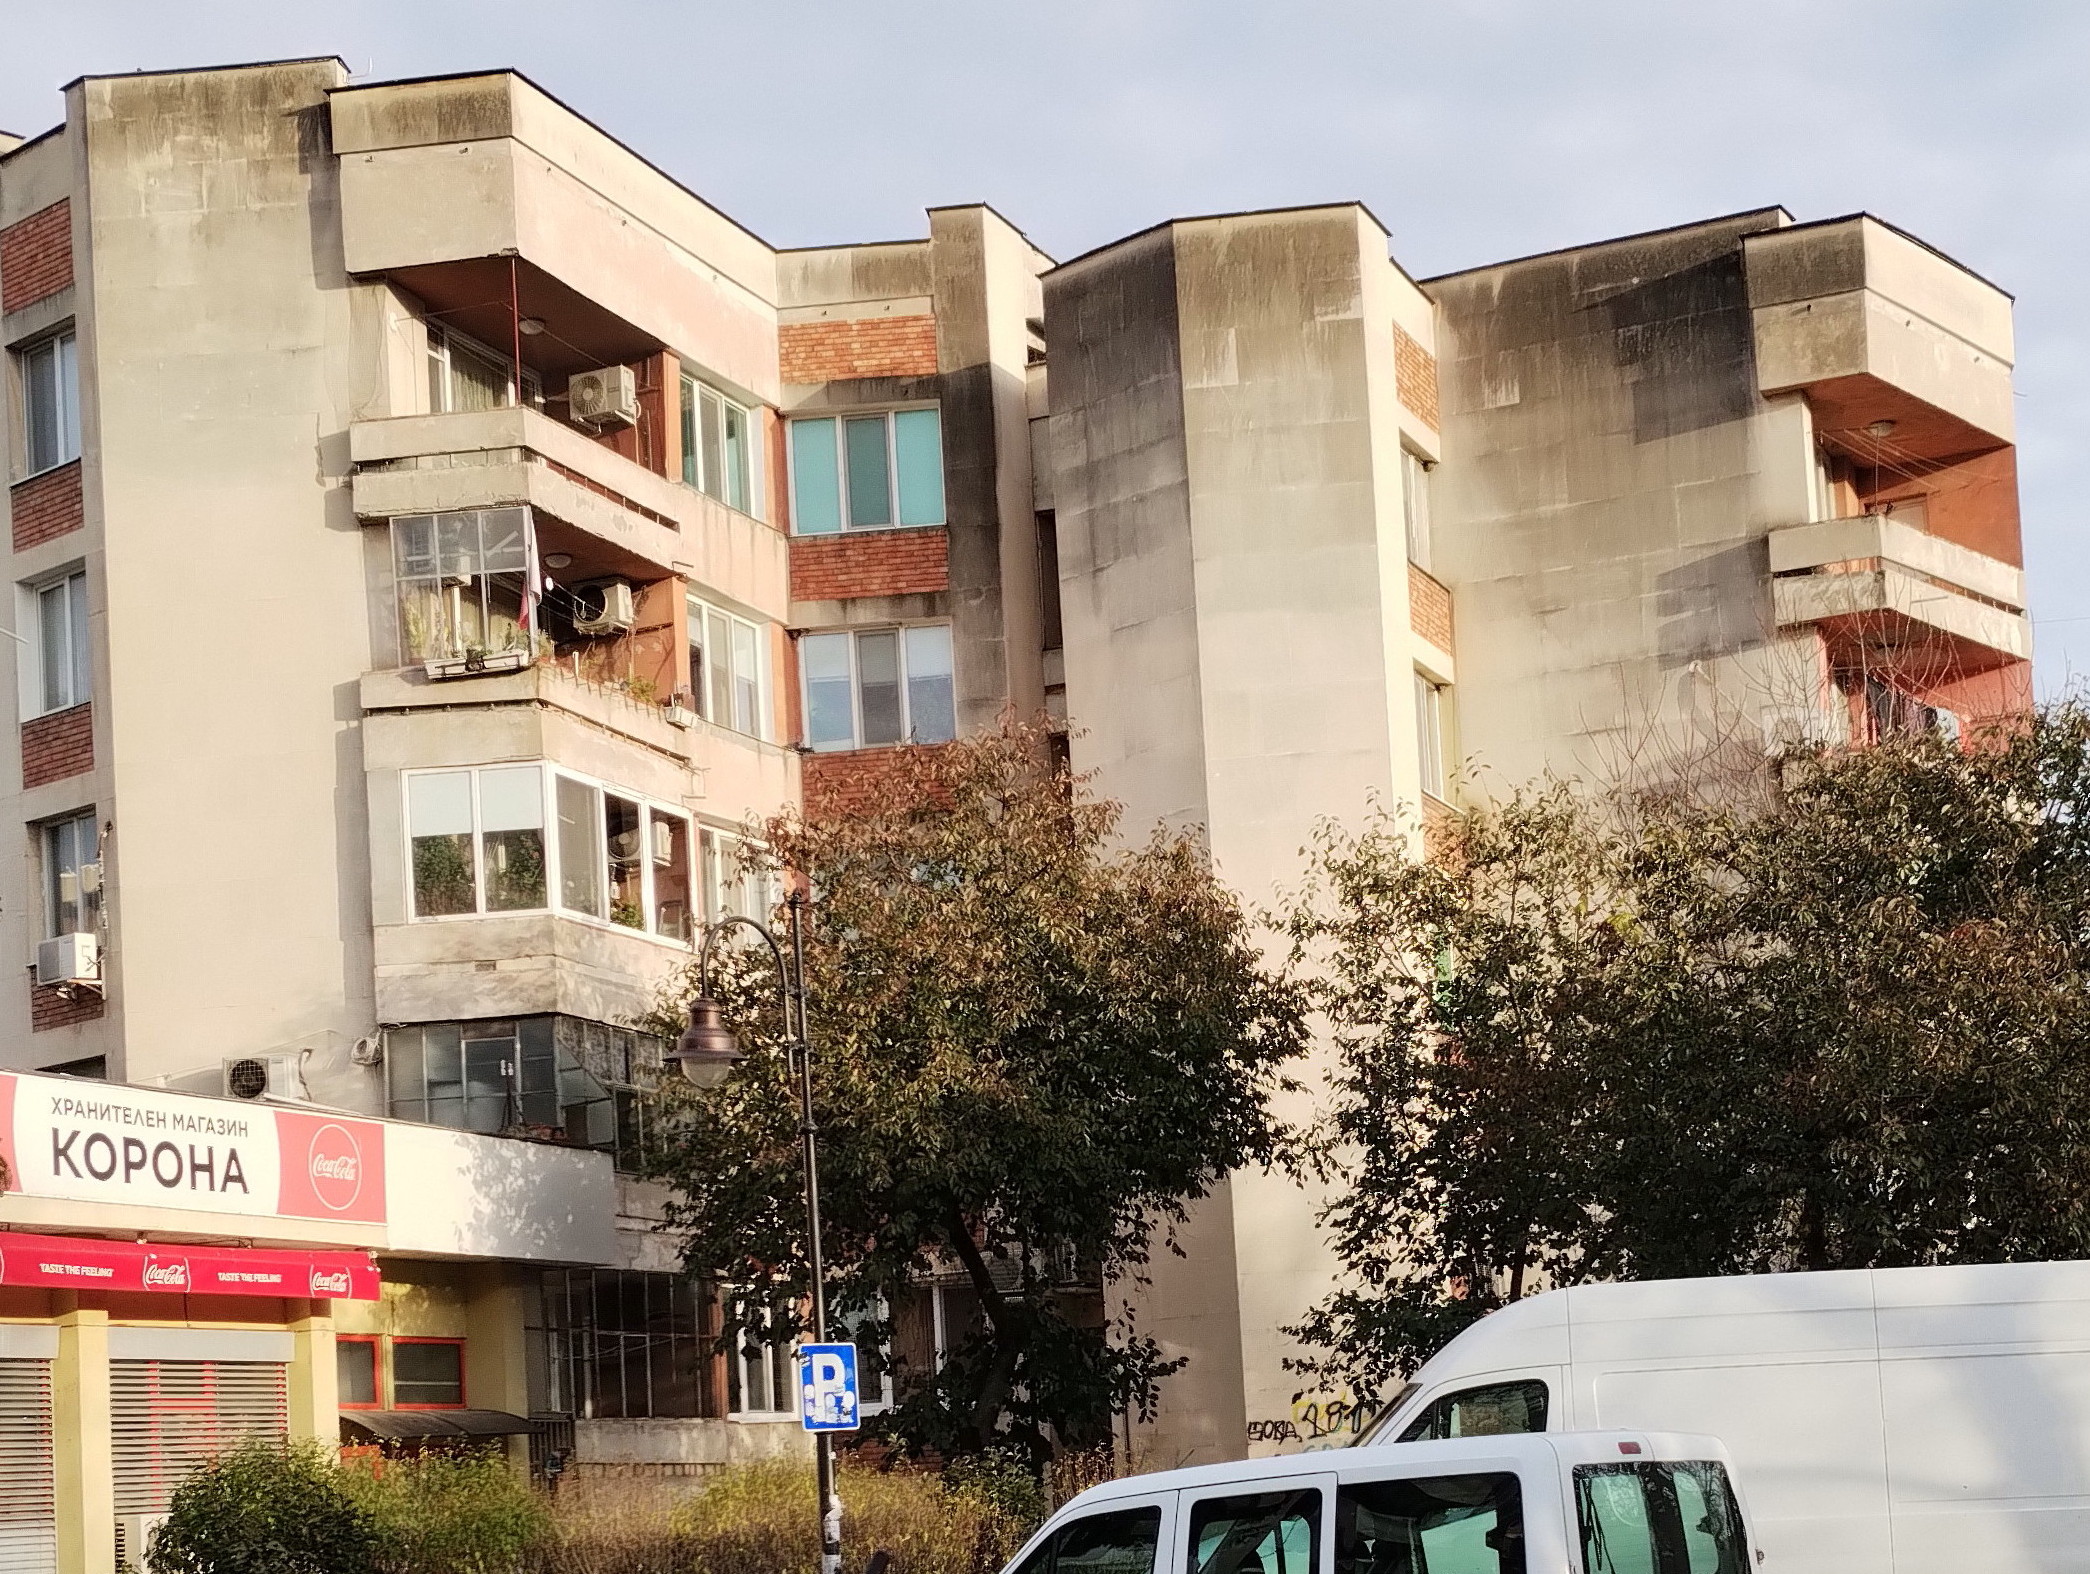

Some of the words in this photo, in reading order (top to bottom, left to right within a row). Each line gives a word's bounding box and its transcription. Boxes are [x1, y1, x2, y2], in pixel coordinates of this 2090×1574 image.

[51, 1097, 167, 1129] ХРАНИТЕЛЕН
[173, 1113, 249, 1138] МАГАЗИН
[51, 1127, 250, 1195] КОРОНА
[39, 1263, 64, 1274] TASTE
[65, 1264, 81, 1275] THE
[217, 1272, 240, 1282] TASTE
[812, 1353, 846, 1421] P
